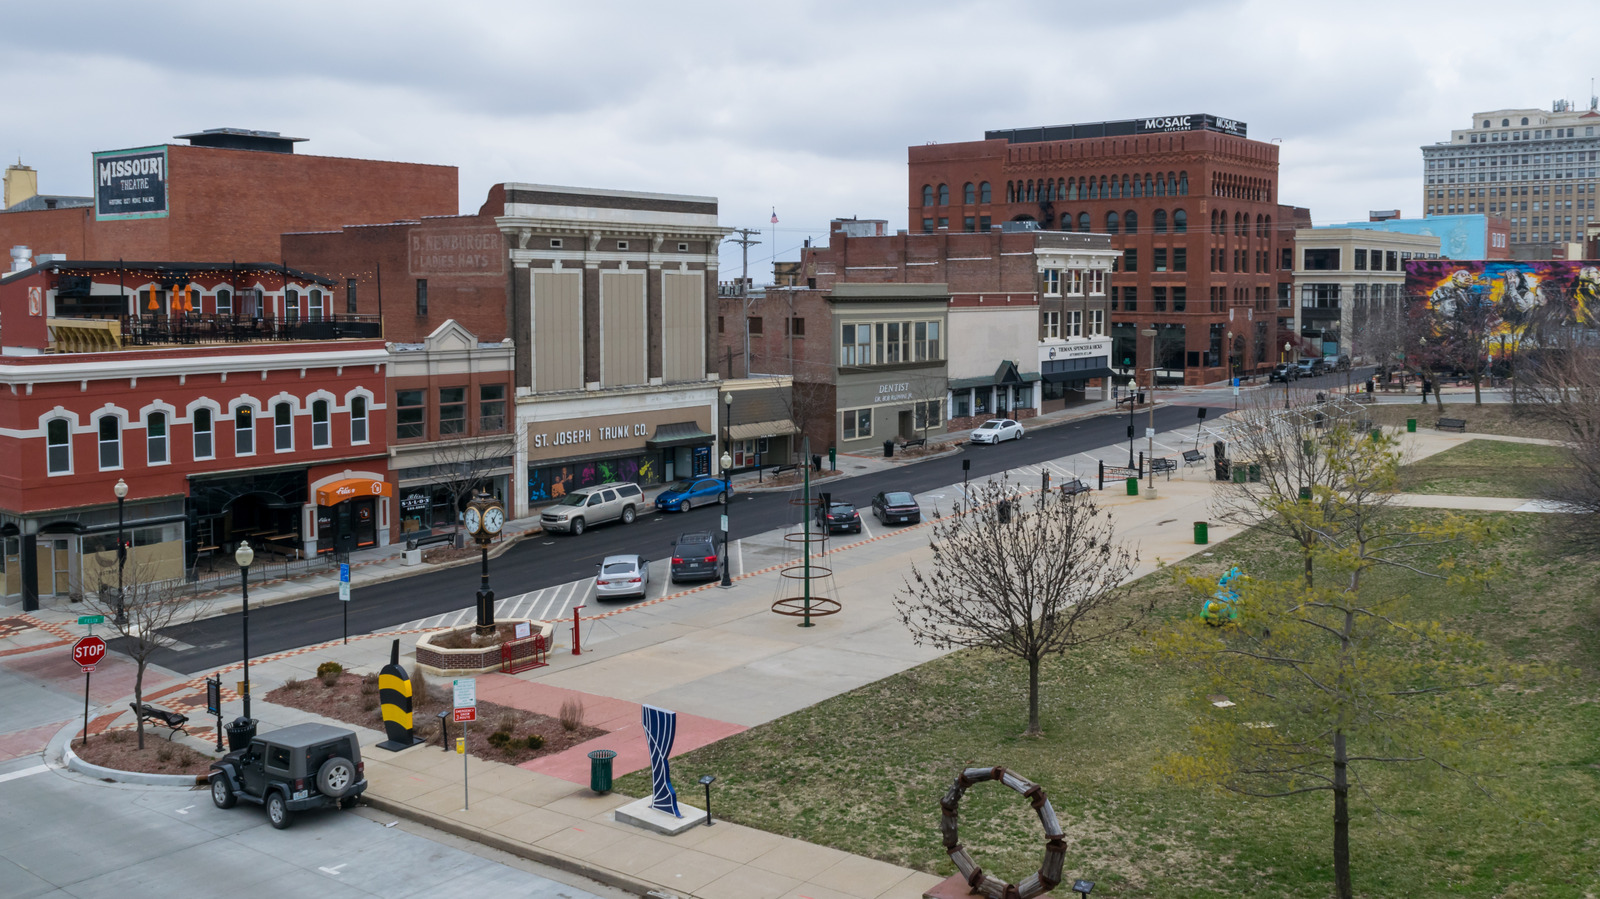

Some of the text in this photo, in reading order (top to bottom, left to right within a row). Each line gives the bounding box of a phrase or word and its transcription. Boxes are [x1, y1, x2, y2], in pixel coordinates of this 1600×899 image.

[1145, 116, 1191, 129] MOSAIC
[1215, 118, 1237, 131] MOSAIC
[100, 157, 163, 187] MISSOURI
[120, 178, 149, 191] THEATRE
[426, 233, 498, 251] NEWBURGER
[420, 254, 489, 268] LADIES HATS
[879, 382, 909, 394] DENTIST
[535, 423, 649, 448] ST. JOSEPH TRUNK CO.
[75, 644, 104, 658] STOP
